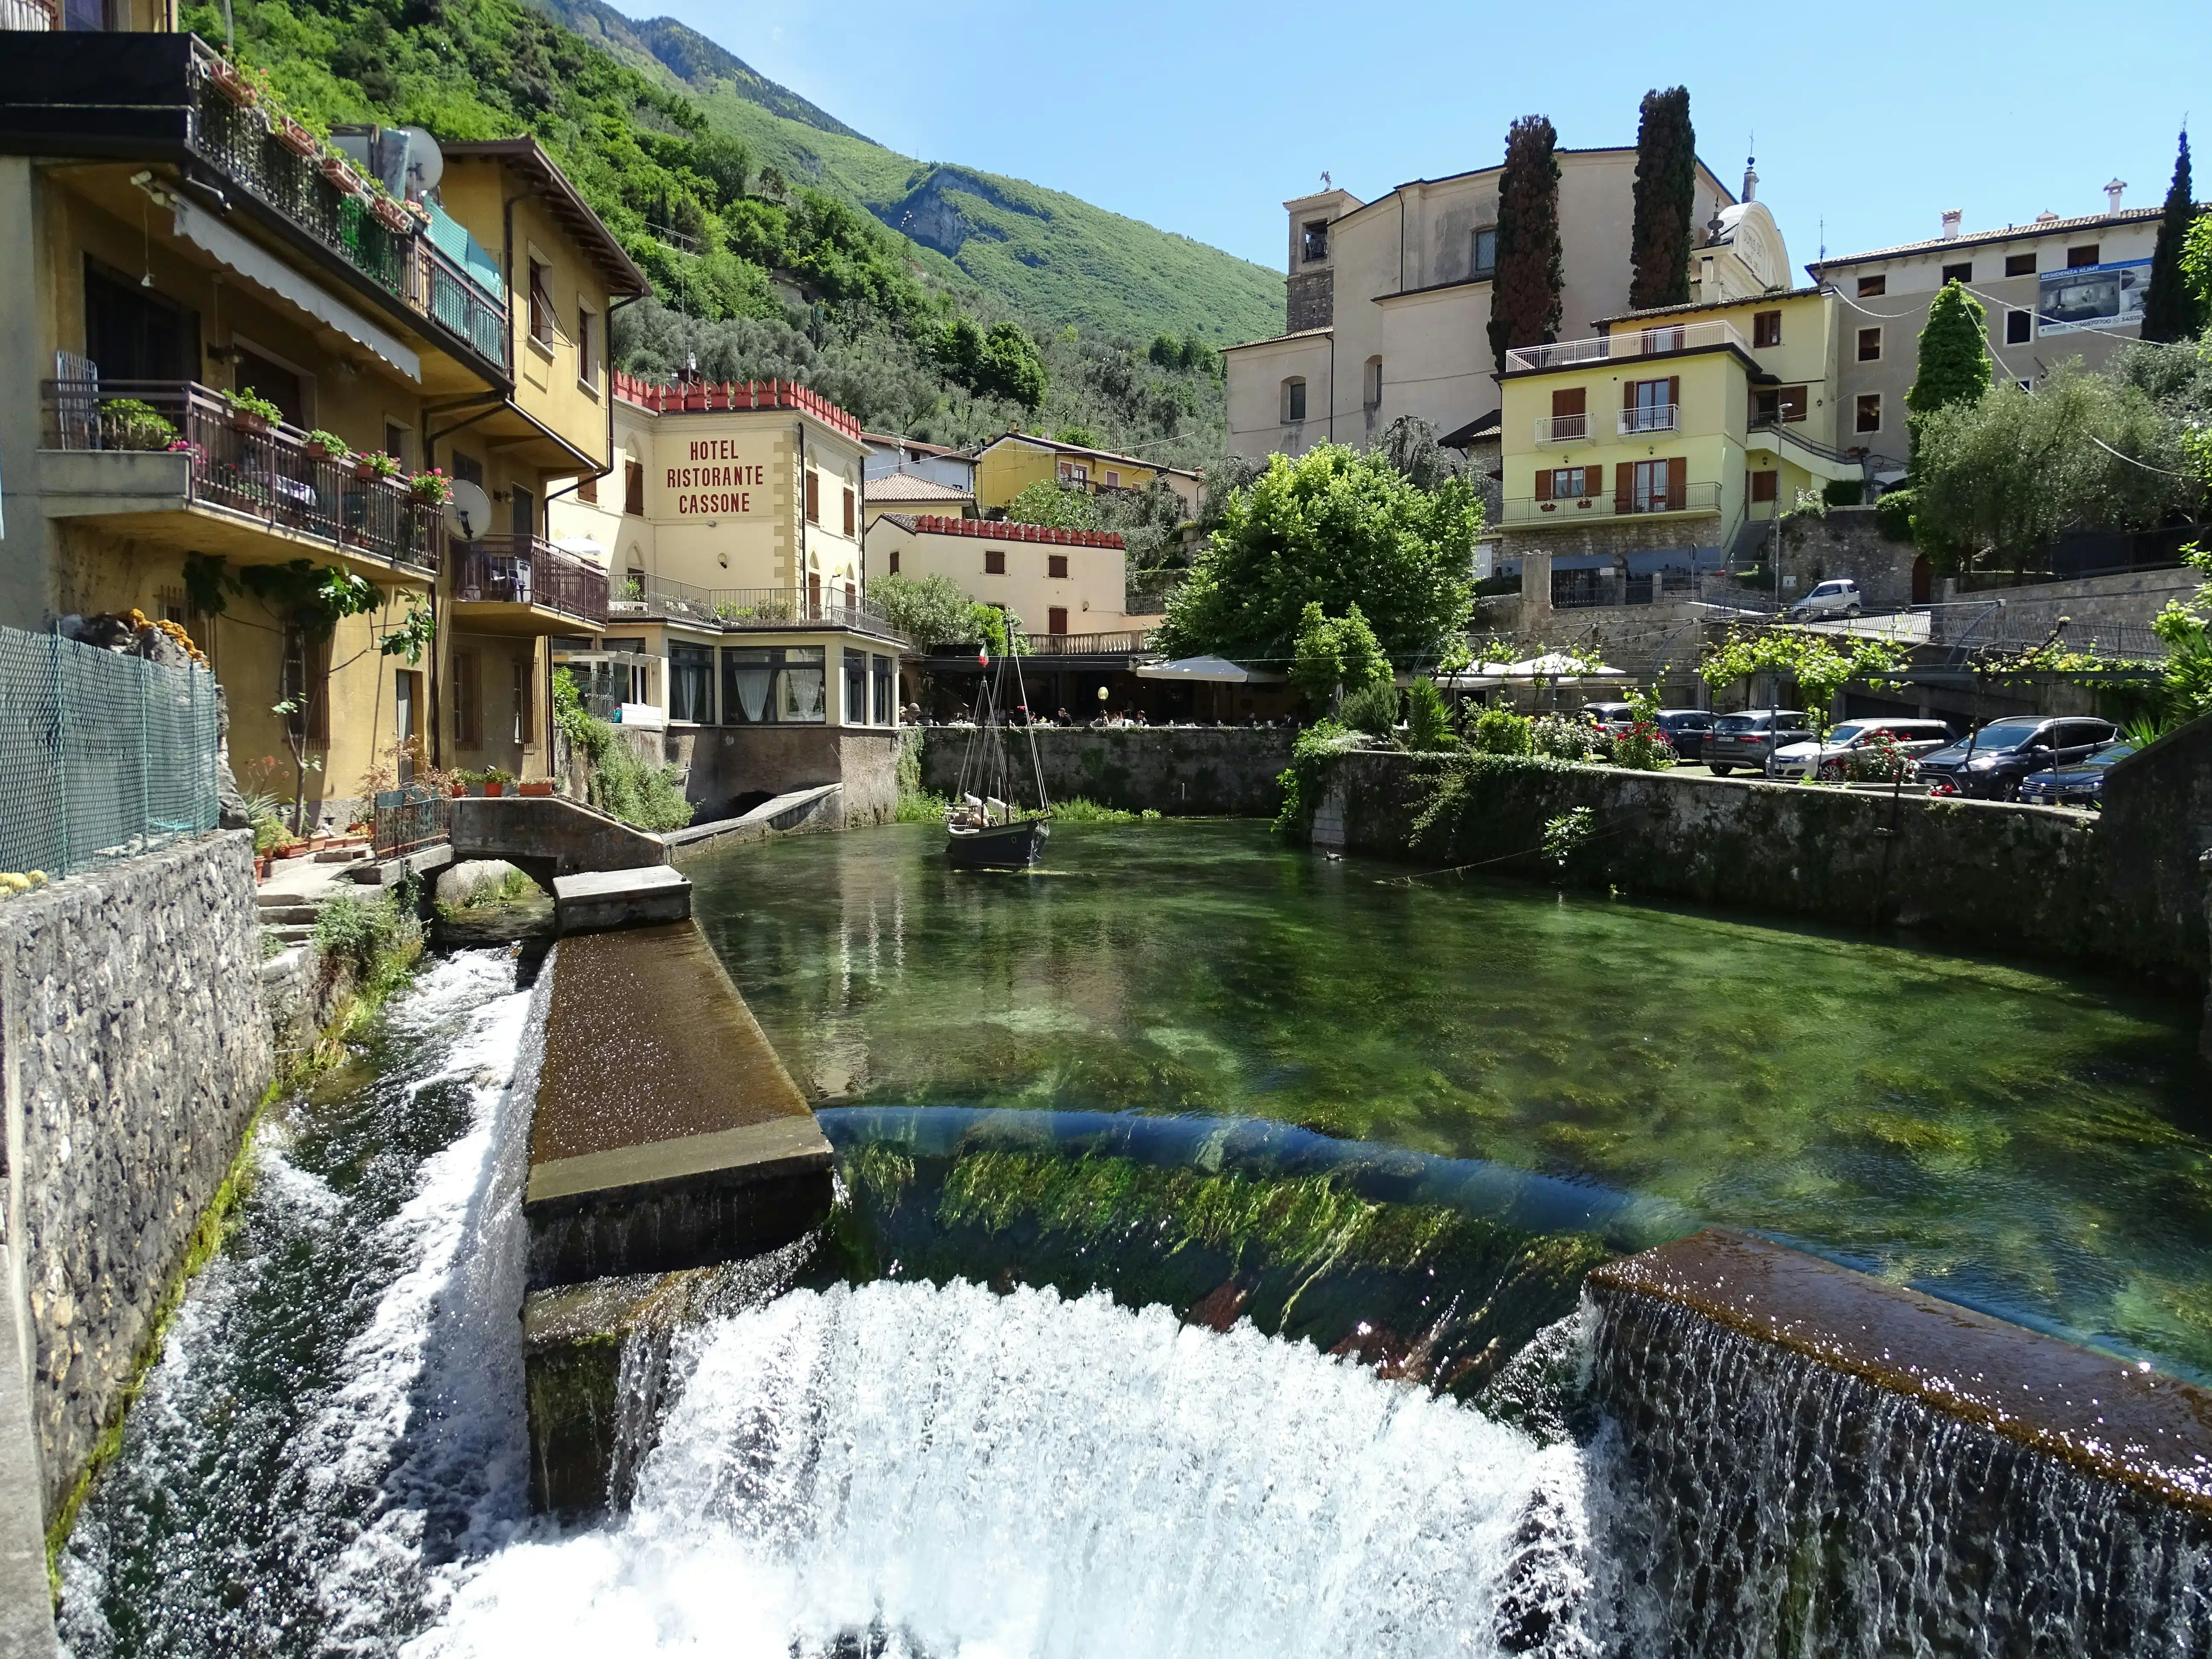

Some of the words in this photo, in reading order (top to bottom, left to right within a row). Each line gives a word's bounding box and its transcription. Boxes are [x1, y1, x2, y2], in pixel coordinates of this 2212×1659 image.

[2041, 270, 2078, 279] RESIDENZA
[2079, 265, 2099, 274] KLIMT
[690, 439, 739, 460] HOTEL
[667, 465, 763, 488] RISTORANTE
[679, 492, 750, 514] CASSONE
